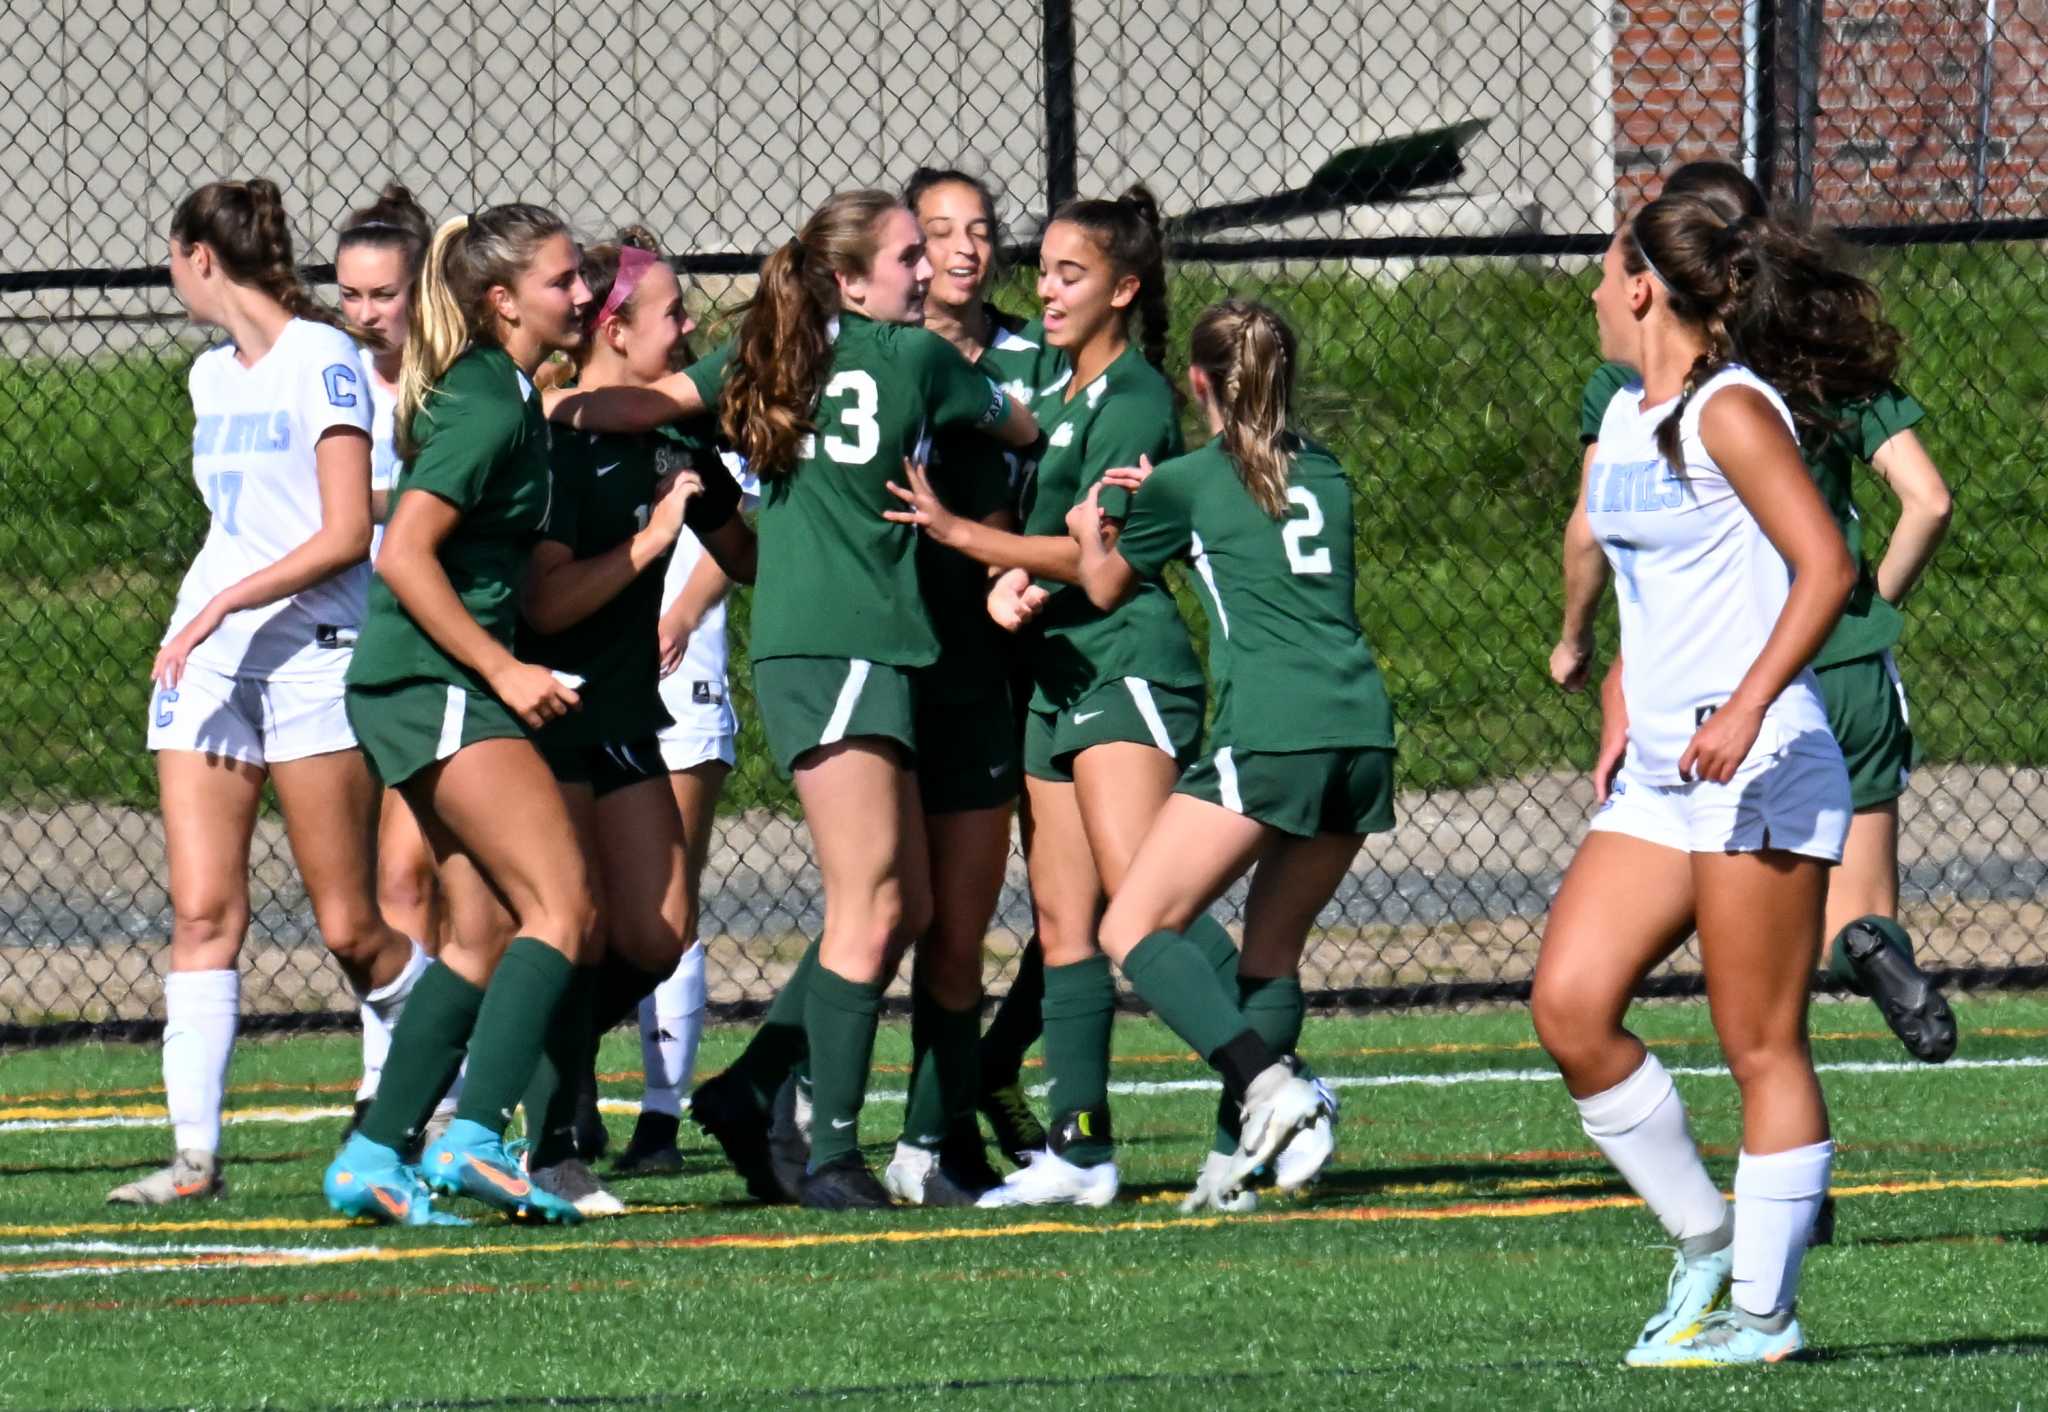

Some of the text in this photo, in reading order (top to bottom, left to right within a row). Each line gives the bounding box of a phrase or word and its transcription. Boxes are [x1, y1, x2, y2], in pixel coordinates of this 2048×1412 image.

[322, 363, 357, 408] C
[780, 370, 880, 464] 3
[1282, 486, 1332, 574] 2
[156, 690, 179, 727] C
